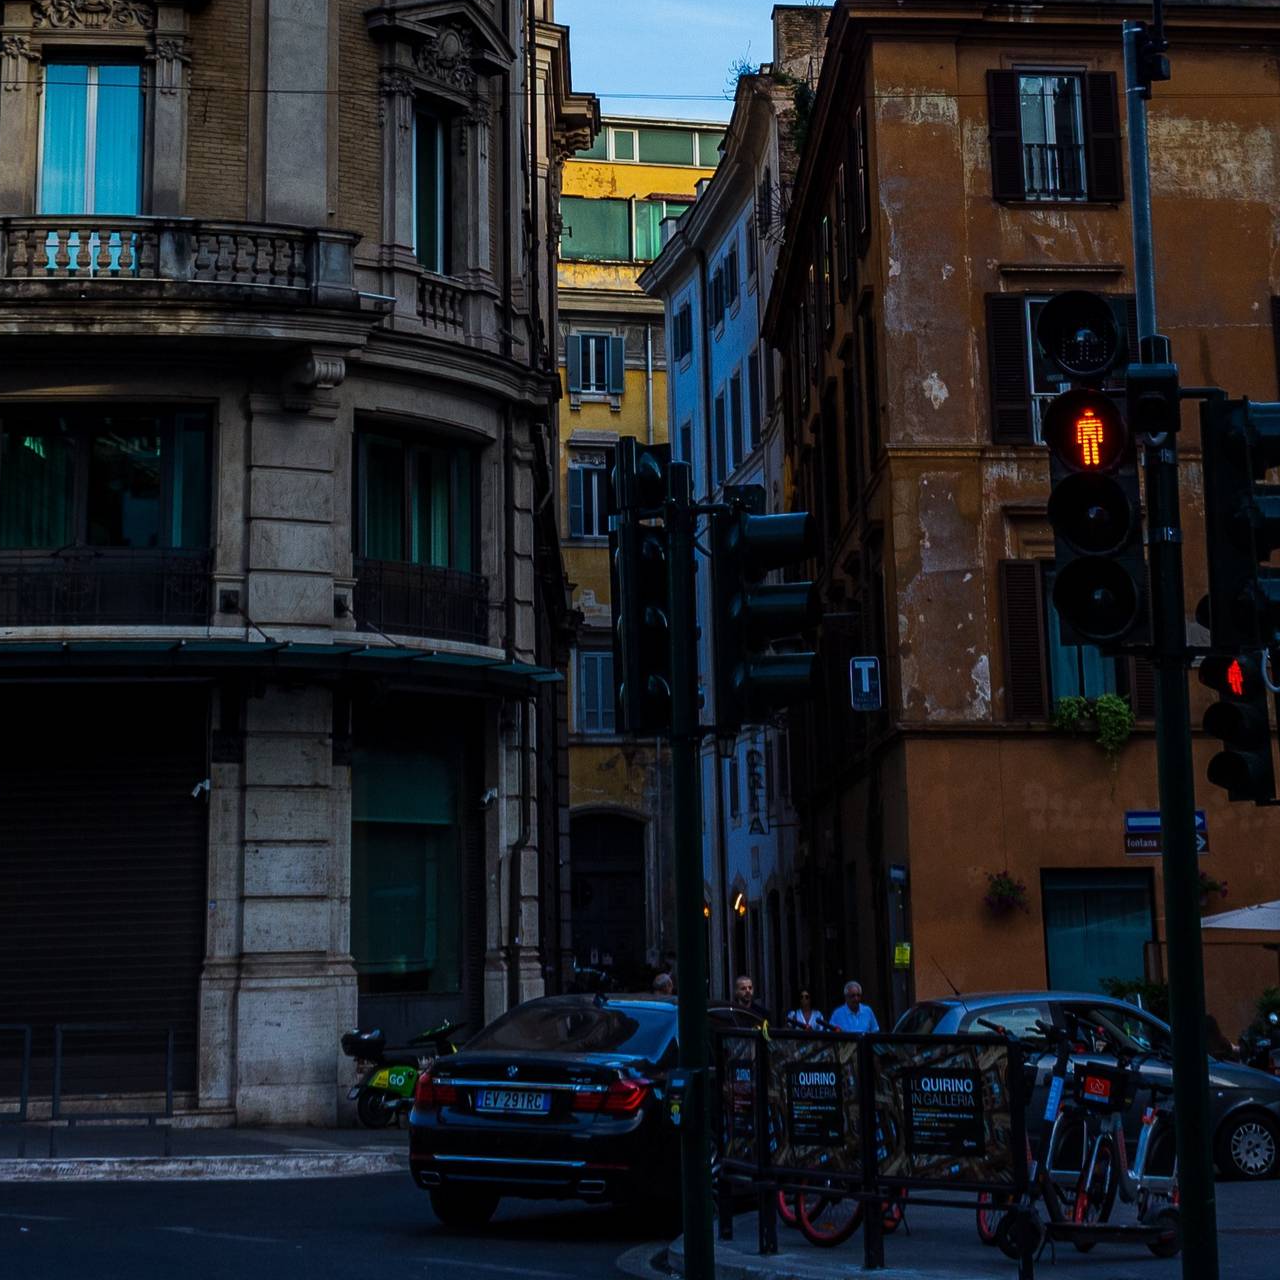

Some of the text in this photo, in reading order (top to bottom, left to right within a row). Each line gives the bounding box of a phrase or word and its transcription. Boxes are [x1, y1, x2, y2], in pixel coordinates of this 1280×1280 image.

[1127, 838, 1158, 848] fontana
[799, 1071, 836, 1086] QUIRINO
[921, 1077, 974, 1093] QUIRINO
[923, 1093, 976, 1106] GALLERIA
